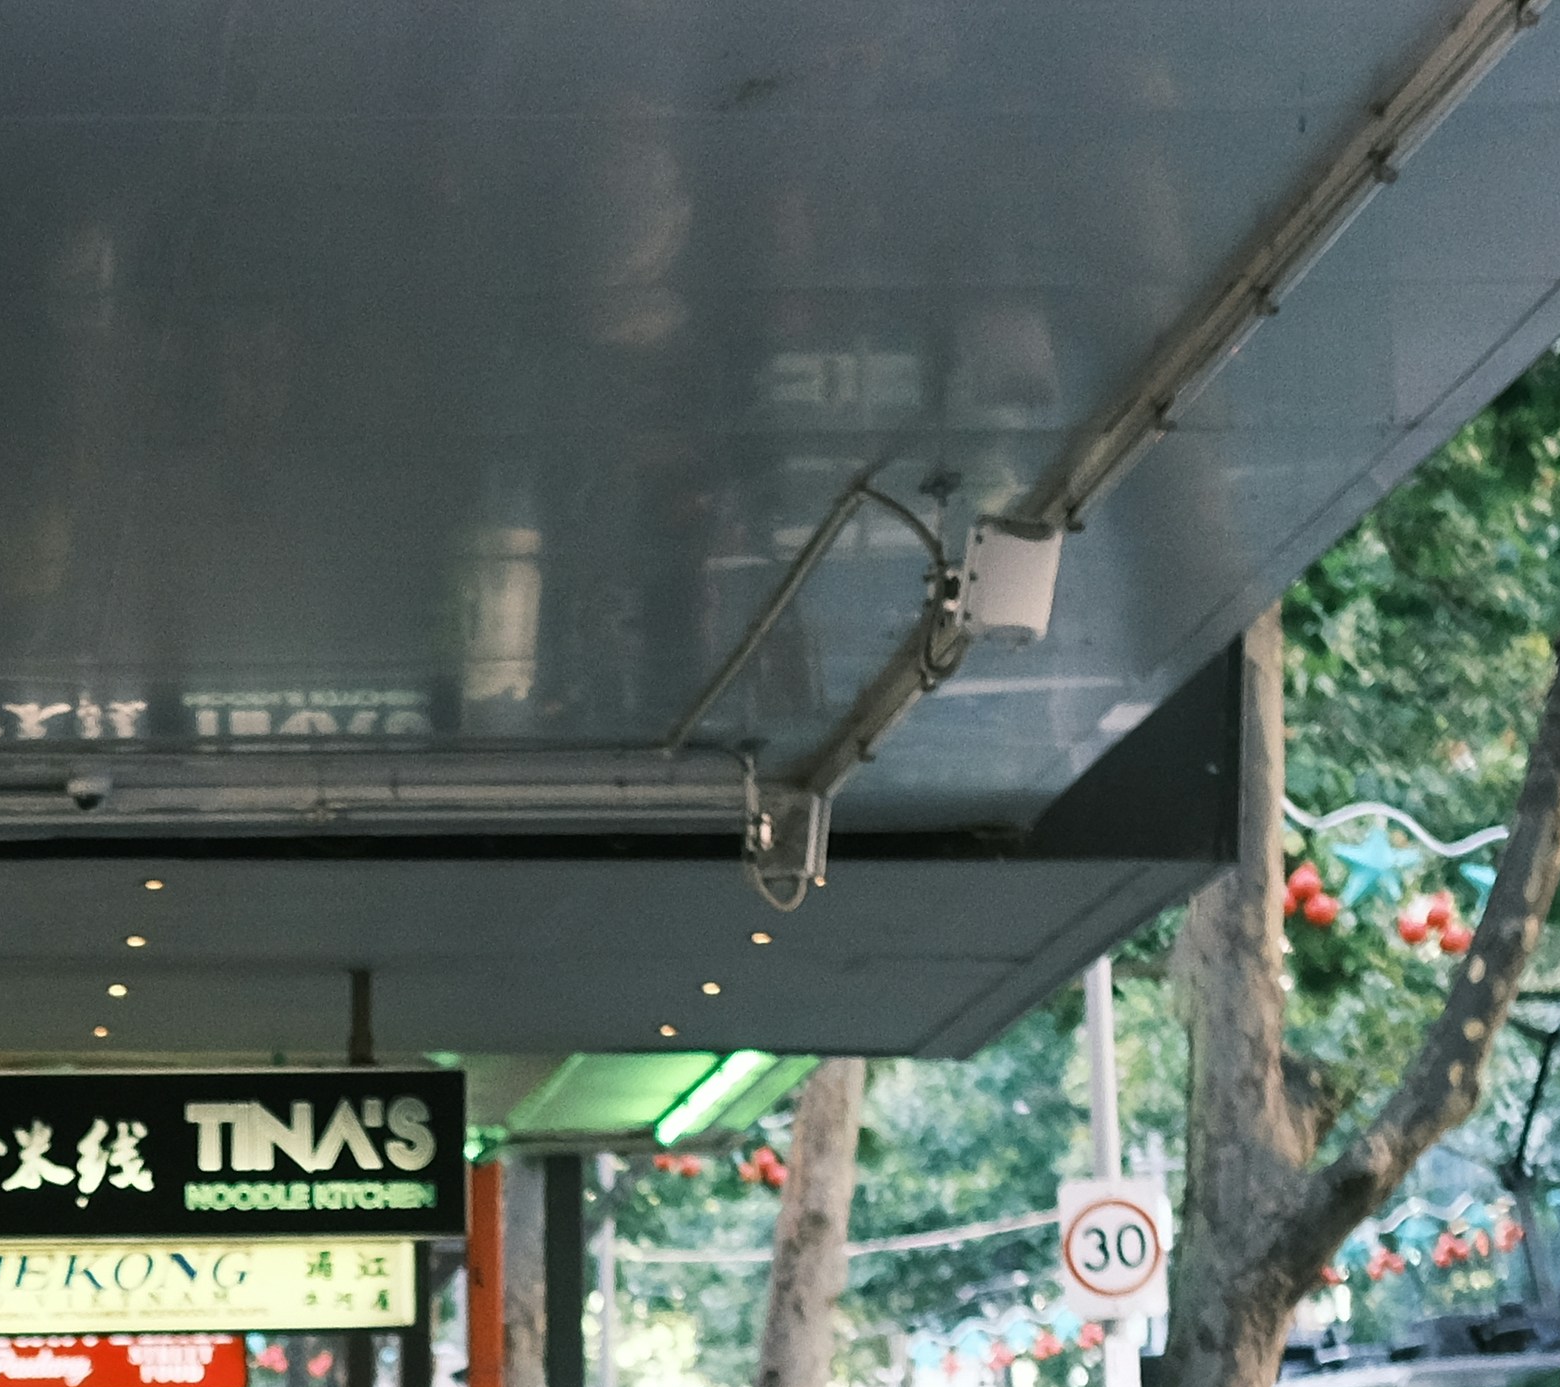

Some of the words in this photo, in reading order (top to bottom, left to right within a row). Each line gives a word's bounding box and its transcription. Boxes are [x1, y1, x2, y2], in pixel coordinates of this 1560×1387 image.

[183, 1096, 437, 1173] TINA'S
[184, 1181, 311, 1211] NOODLE
[312, 1180, 438, 1210] KITCHEN
[1083, 1223, 1146, 1271] 30
